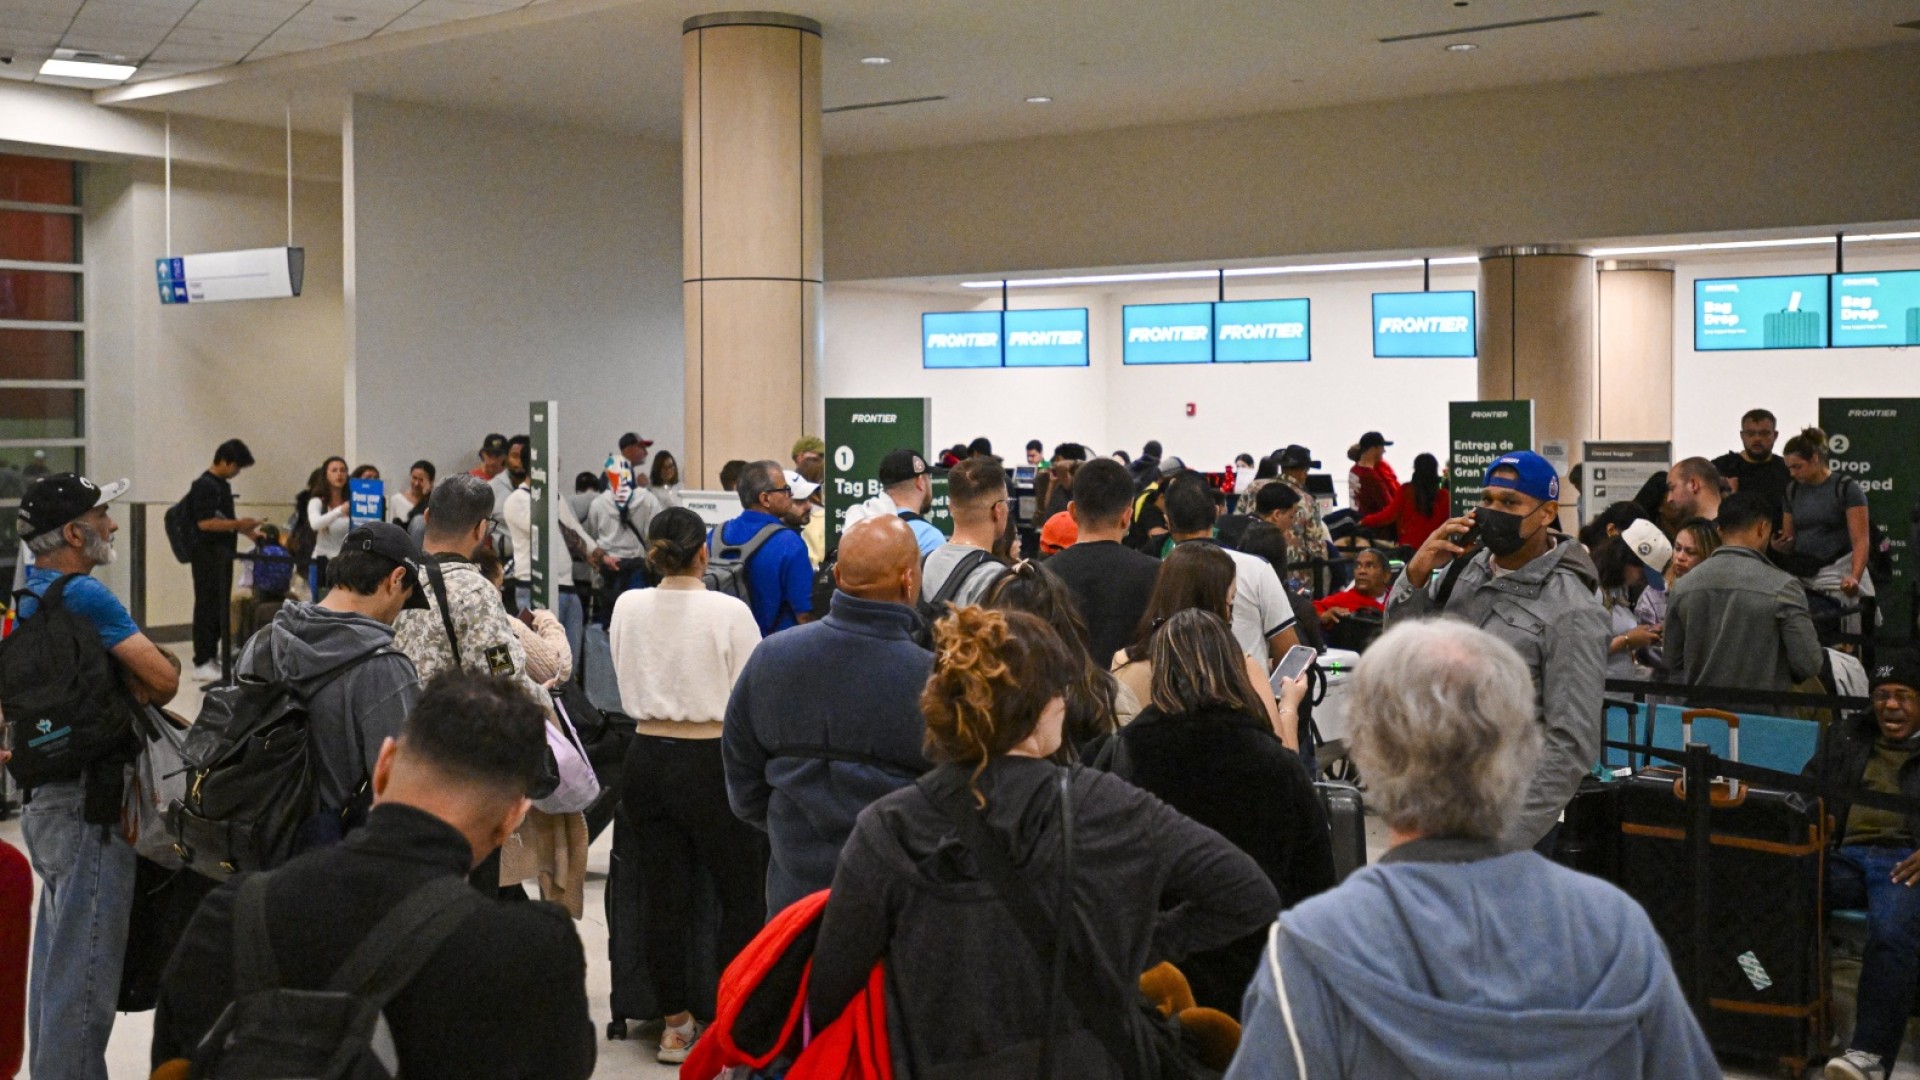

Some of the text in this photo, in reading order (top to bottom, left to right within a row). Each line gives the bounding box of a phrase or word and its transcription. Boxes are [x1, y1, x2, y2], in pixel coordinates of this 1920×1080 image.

[1378, 315, 1469, 333] FRONTIER
[1704, 314, 1739, 327] Drop
[1008, 330, 1083, 346] FRONTIER
[1128, 325, 1208, 342] FRONTIER
[1219, 322, 1304, 340] FRONTIER
[927, 332, 998, 348] FRONTIER
[852, 413, 897, 423] FRONTIER
[1848, 409, 1897, 417] FRONTIER
[1454, 440, 1514, 452] Entrega de
[1834, 438, 1844, 450] 2
[1454, 467, 1480, 477] Gran
[1829, 459, 1871, 474] Drop
[835, 478, 864, 498] Tag
